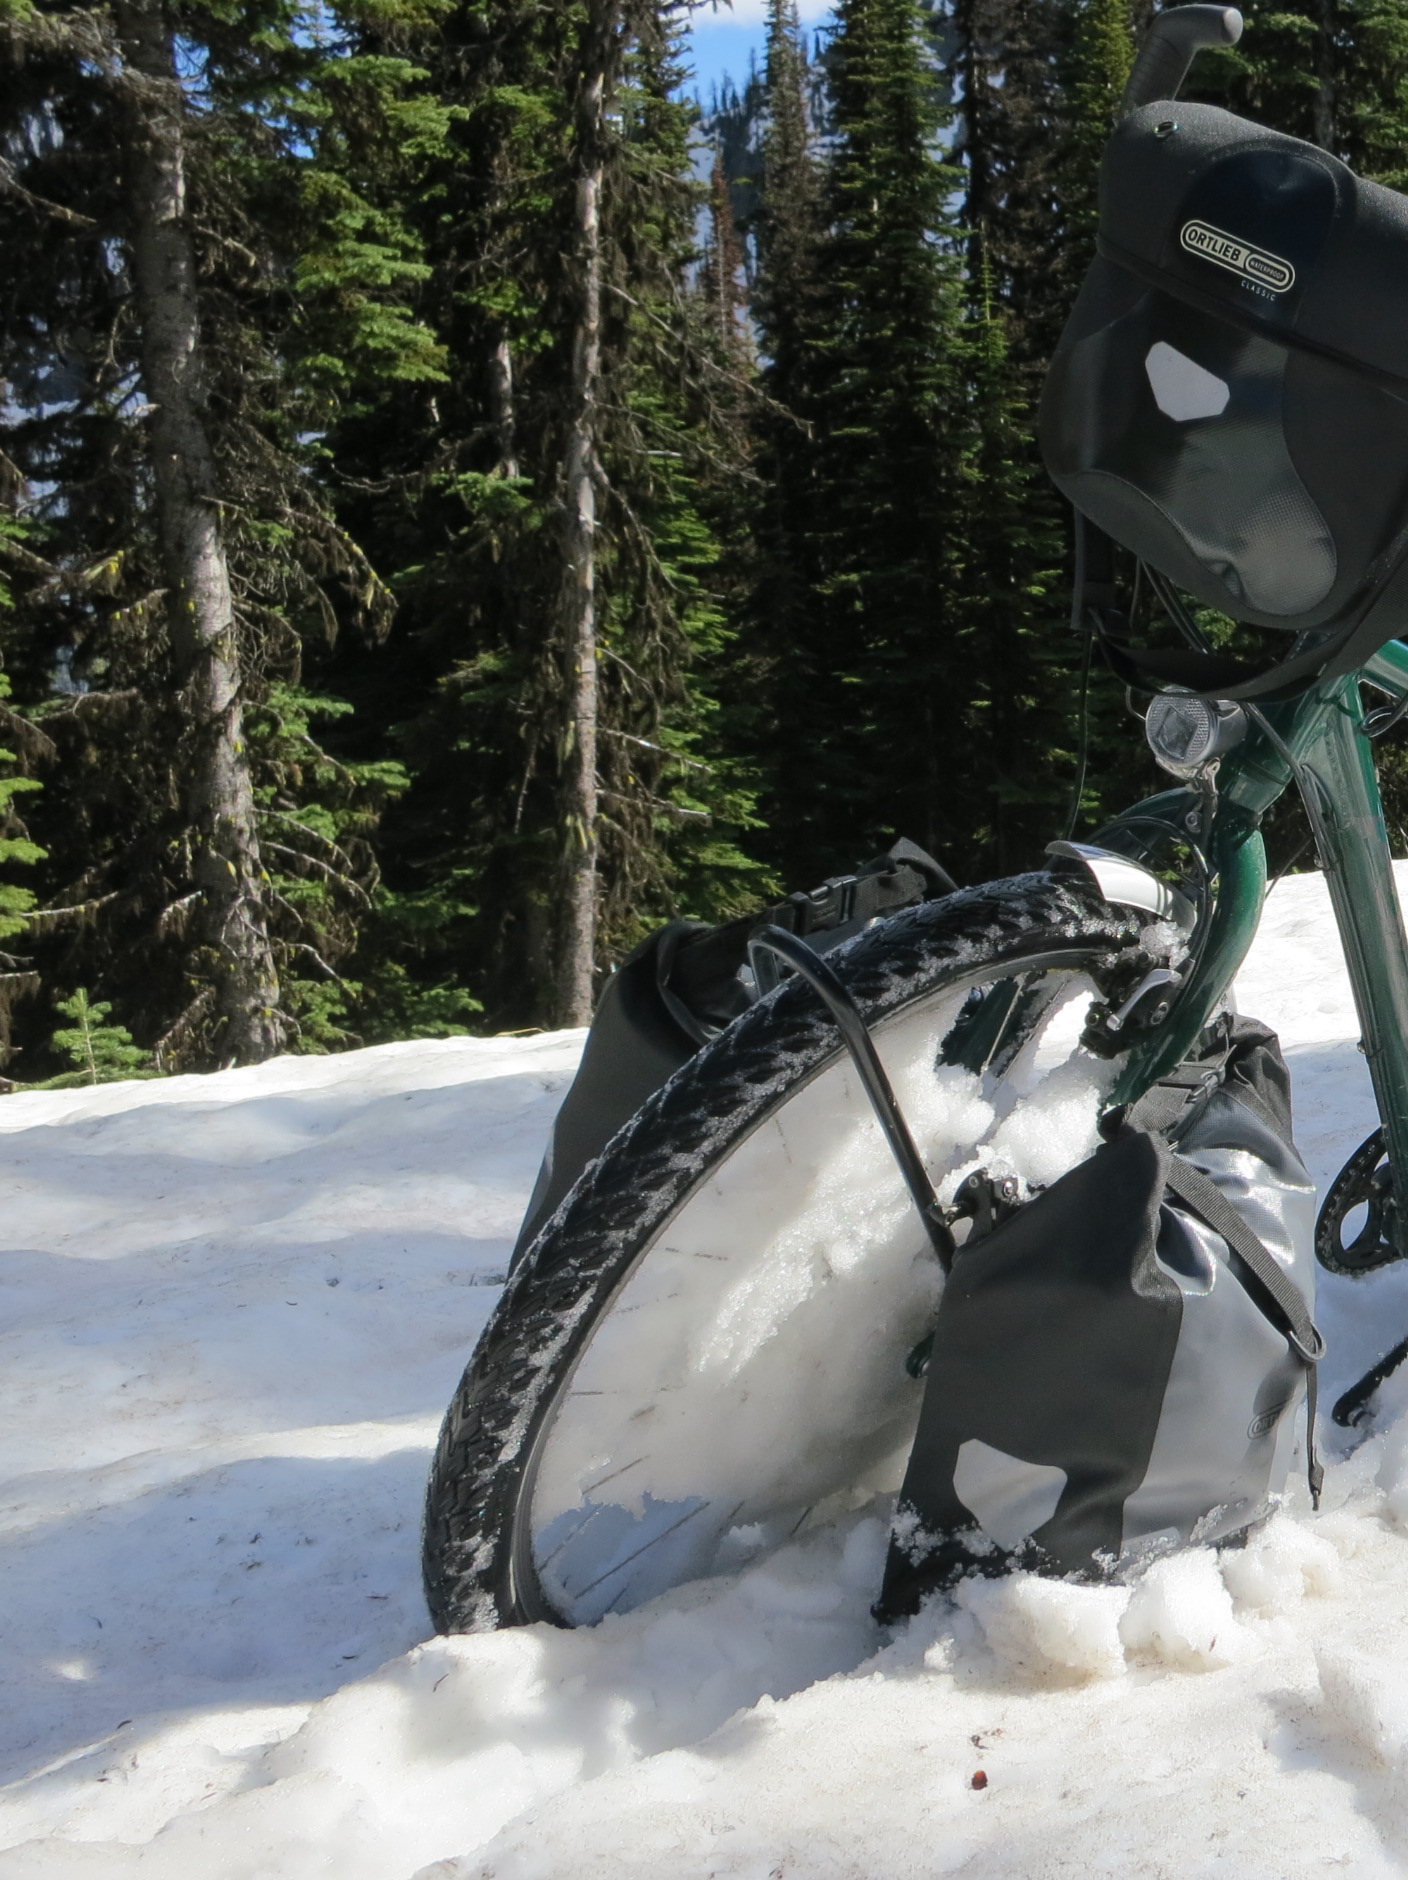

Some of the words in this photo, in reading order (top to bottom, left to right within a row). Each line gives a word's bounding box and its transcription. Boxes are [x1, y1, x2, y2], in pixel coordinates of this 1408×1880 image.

[1188, 228, 1242, 262] ORTLIEB
[1250, 260, 1284, 280] WATERPROOF
[1241, 280, 1276, 301] CLASSIC
